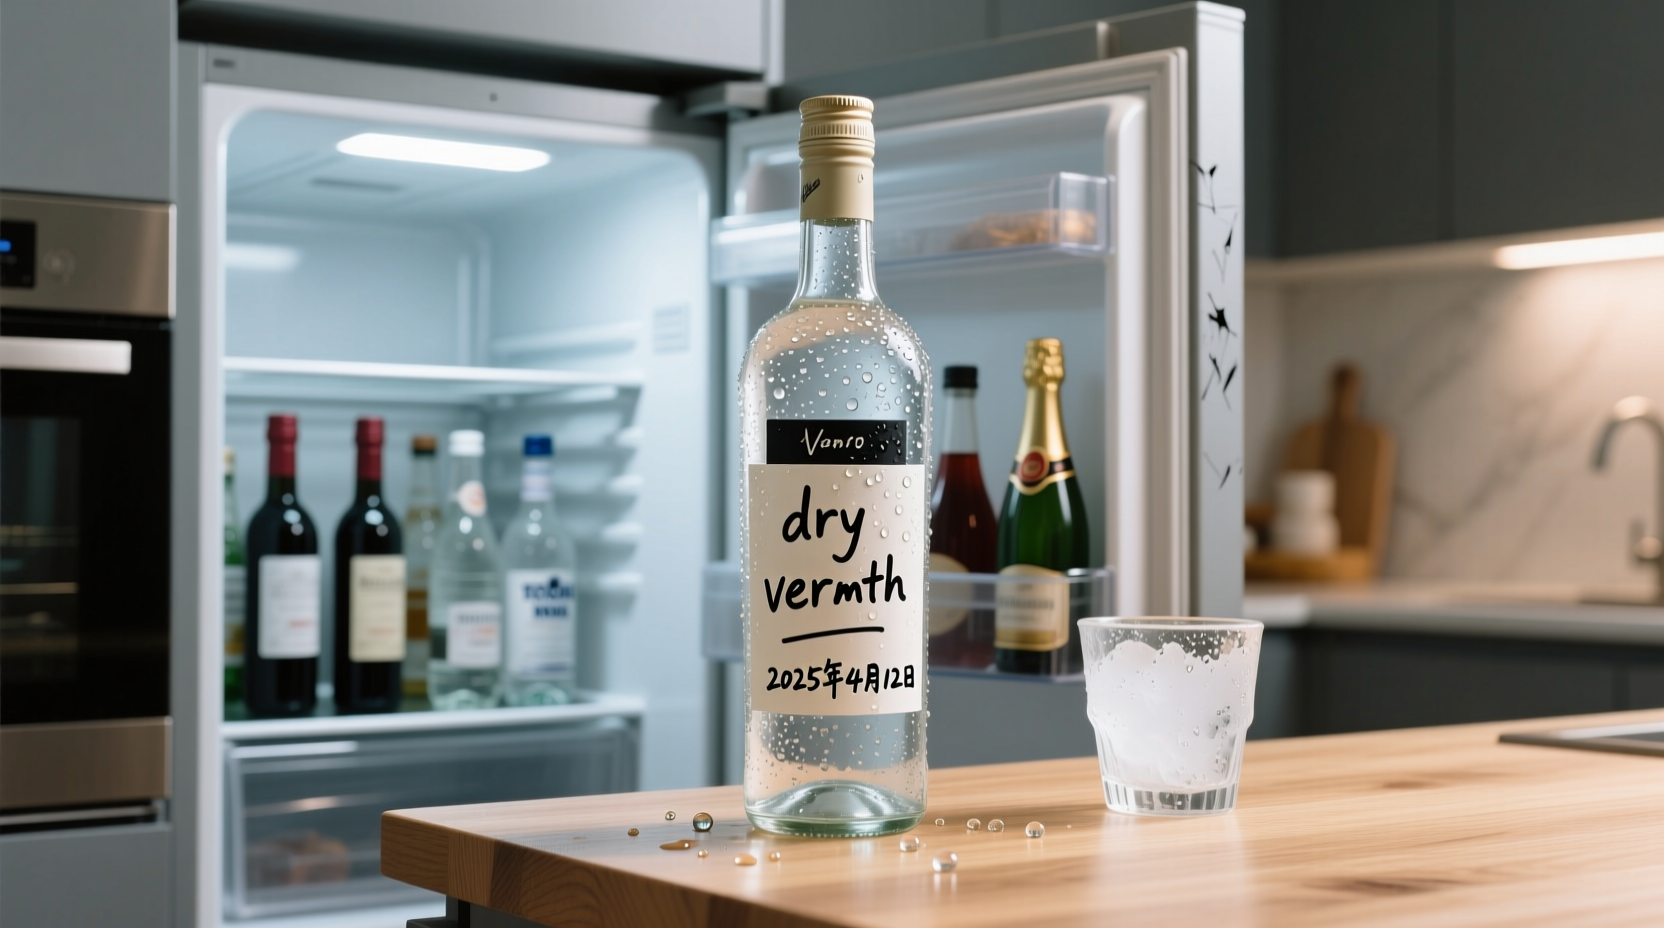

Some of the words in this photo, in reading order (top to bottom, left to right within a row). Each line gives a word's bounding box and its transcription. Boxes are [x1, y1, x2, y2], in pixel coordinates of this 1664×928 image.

[781, 484, 866, 564] dry
[763, 553, 907, 614] vermth
[766, 657, 915, 700] 2025年4月12日
